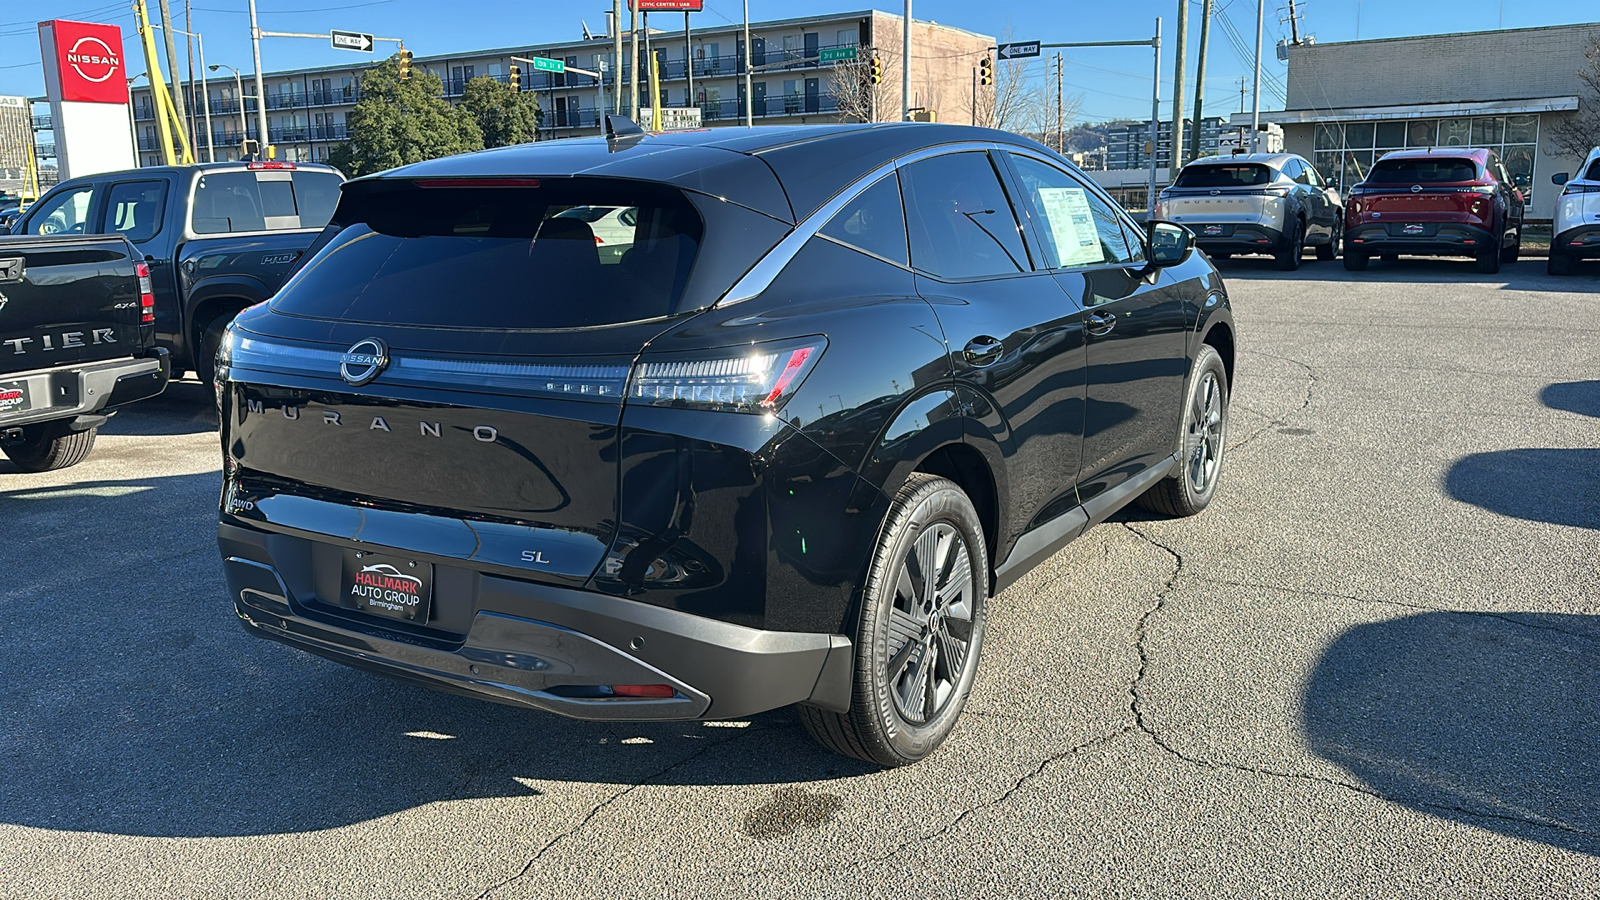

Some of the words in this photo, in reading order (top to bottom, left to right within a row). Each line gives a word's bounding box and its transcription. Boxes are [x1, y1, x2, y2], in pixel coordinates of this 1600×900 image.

[1010, 46, 1021, 54] ONE
[1023, 45, 1036, 53] WAY
[67, 53, 119, 65] NISSAN
[342, 354, 382, 364] NISSAN
[247, 399, 498, 443] MURANO
[232, 498, 254, 510] AWD
[521, 550, 550, 564] SL
[355, 572, 418, 595] HALLMARK
[351, 584, 382, 599] AUTO
[384, 589, 420, 607] GROUP
[369, 598, 404, 611] Birmingham
